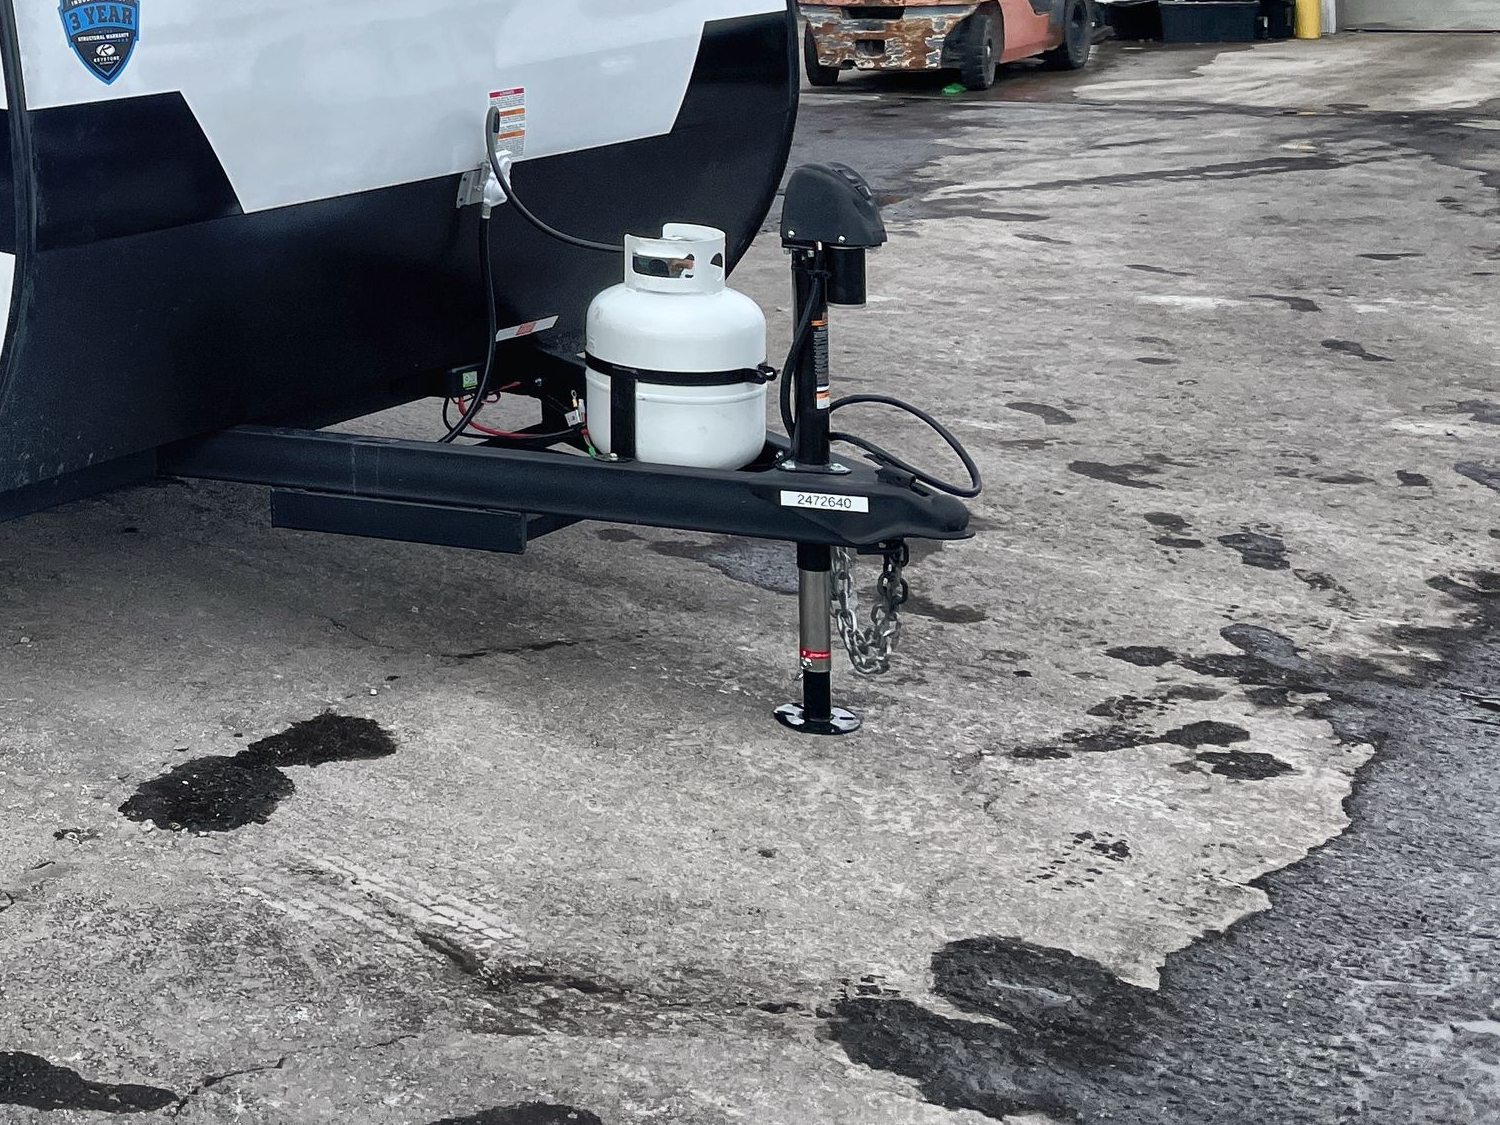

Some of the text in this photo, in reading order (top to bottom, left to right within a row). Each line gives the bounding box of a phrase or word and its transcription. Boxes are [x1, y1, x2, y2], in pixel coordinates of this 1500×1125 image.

[68, 5, 132, 30] 3 YEAR
[797, 494, 852, 509] 2472640
